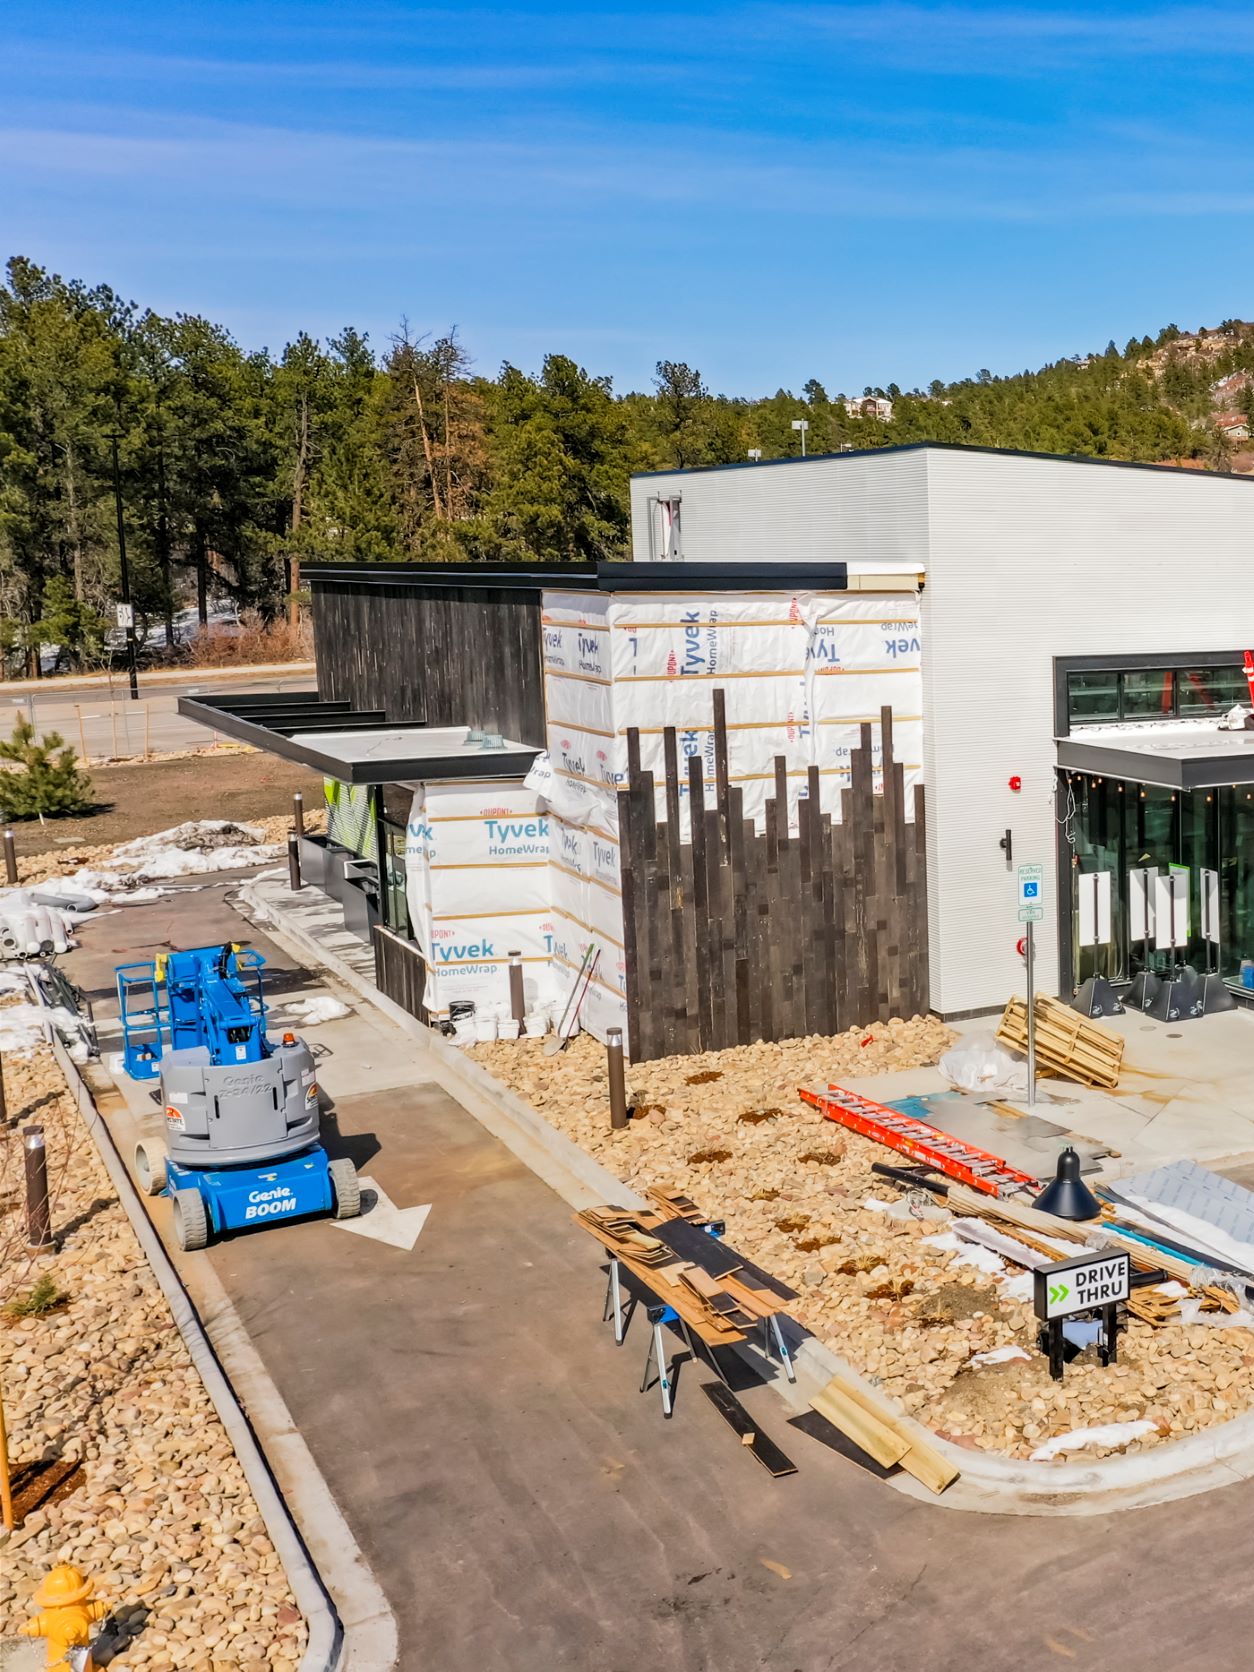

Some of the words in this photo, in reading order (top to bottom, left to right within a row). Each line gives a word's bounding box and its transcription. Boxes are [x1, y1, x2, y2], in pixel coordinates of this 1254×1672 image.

[680, 611, 705, 675] Tyvek
[484, 819, 549, 843] Tyvek
[249, 1187, 293, 1203] Genie
[245, 1198, 297, 1219] BOOM
[1076, 1262, 1125, 1287] DRIVE
[1077, 1280, 1122, 1304] THRU
